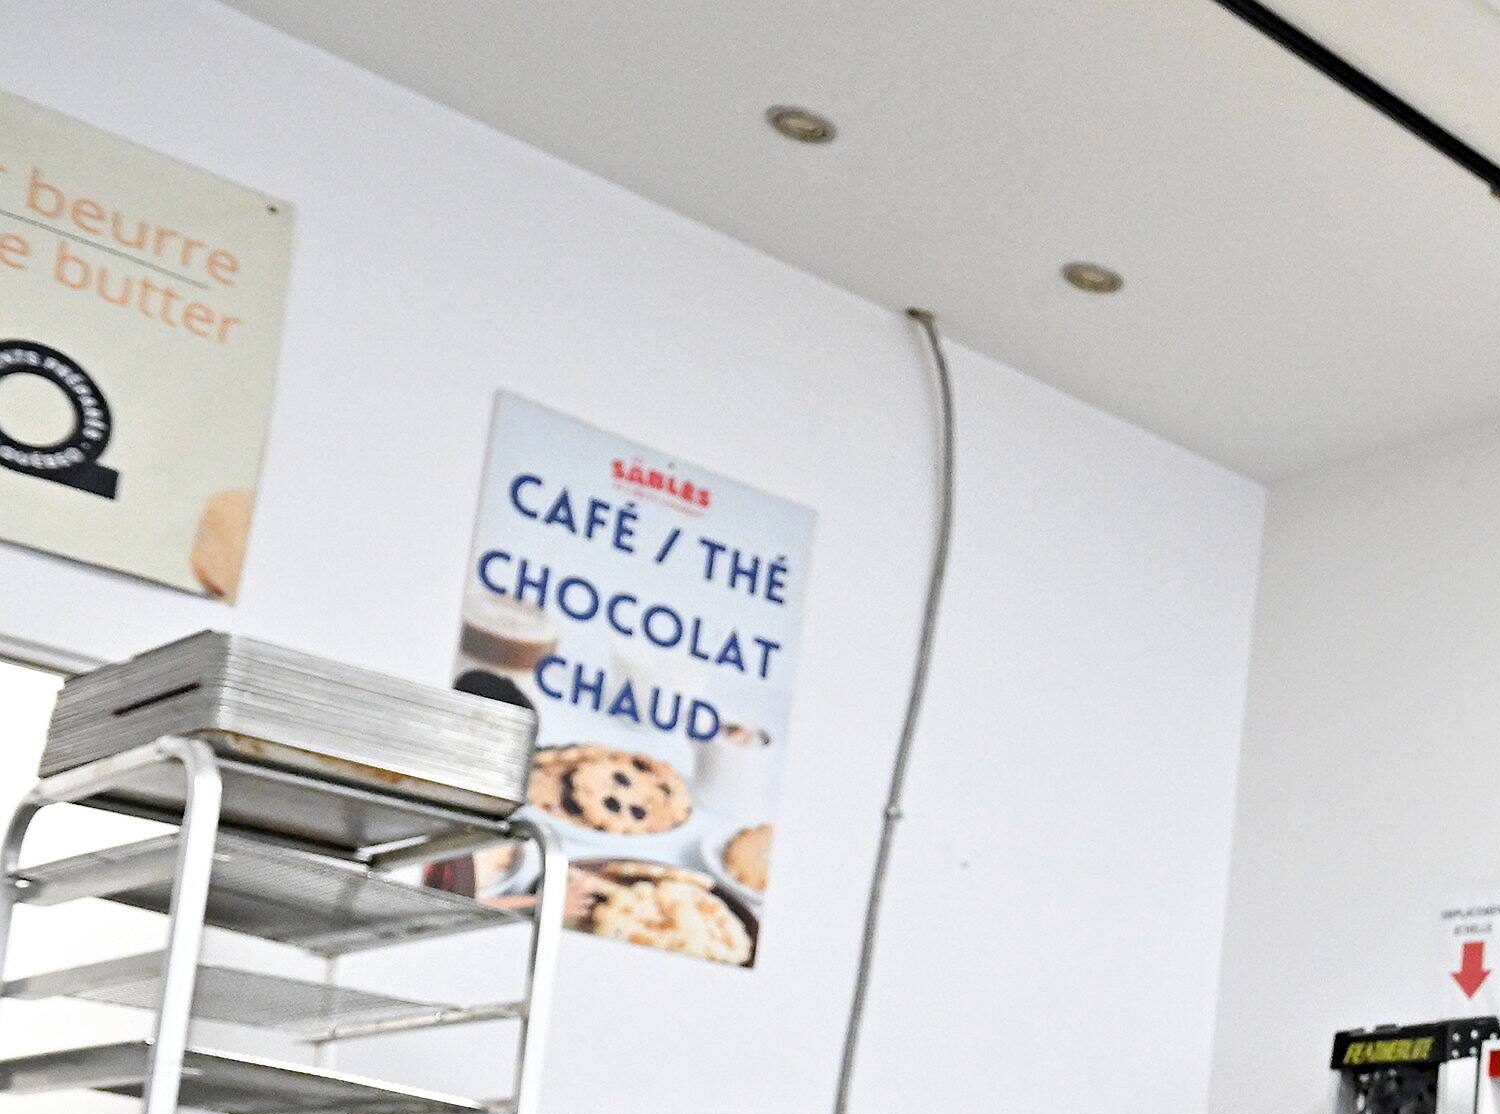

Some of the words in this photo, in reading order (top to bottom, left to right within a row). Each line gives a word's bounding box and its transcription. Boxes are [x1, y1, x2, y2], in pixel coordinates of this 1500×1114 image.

[27, 166, 241, 287] beurre
[54, 239, 242, 343] butter
[509, 474, 640, 555] CAFÉ
[655, 529, 682, 564] /
[698, 536, 790, 604] THÉ
[478, 549, 782, 679] CHOCOLAT
[534, 655, 721, 743] CHAUD
